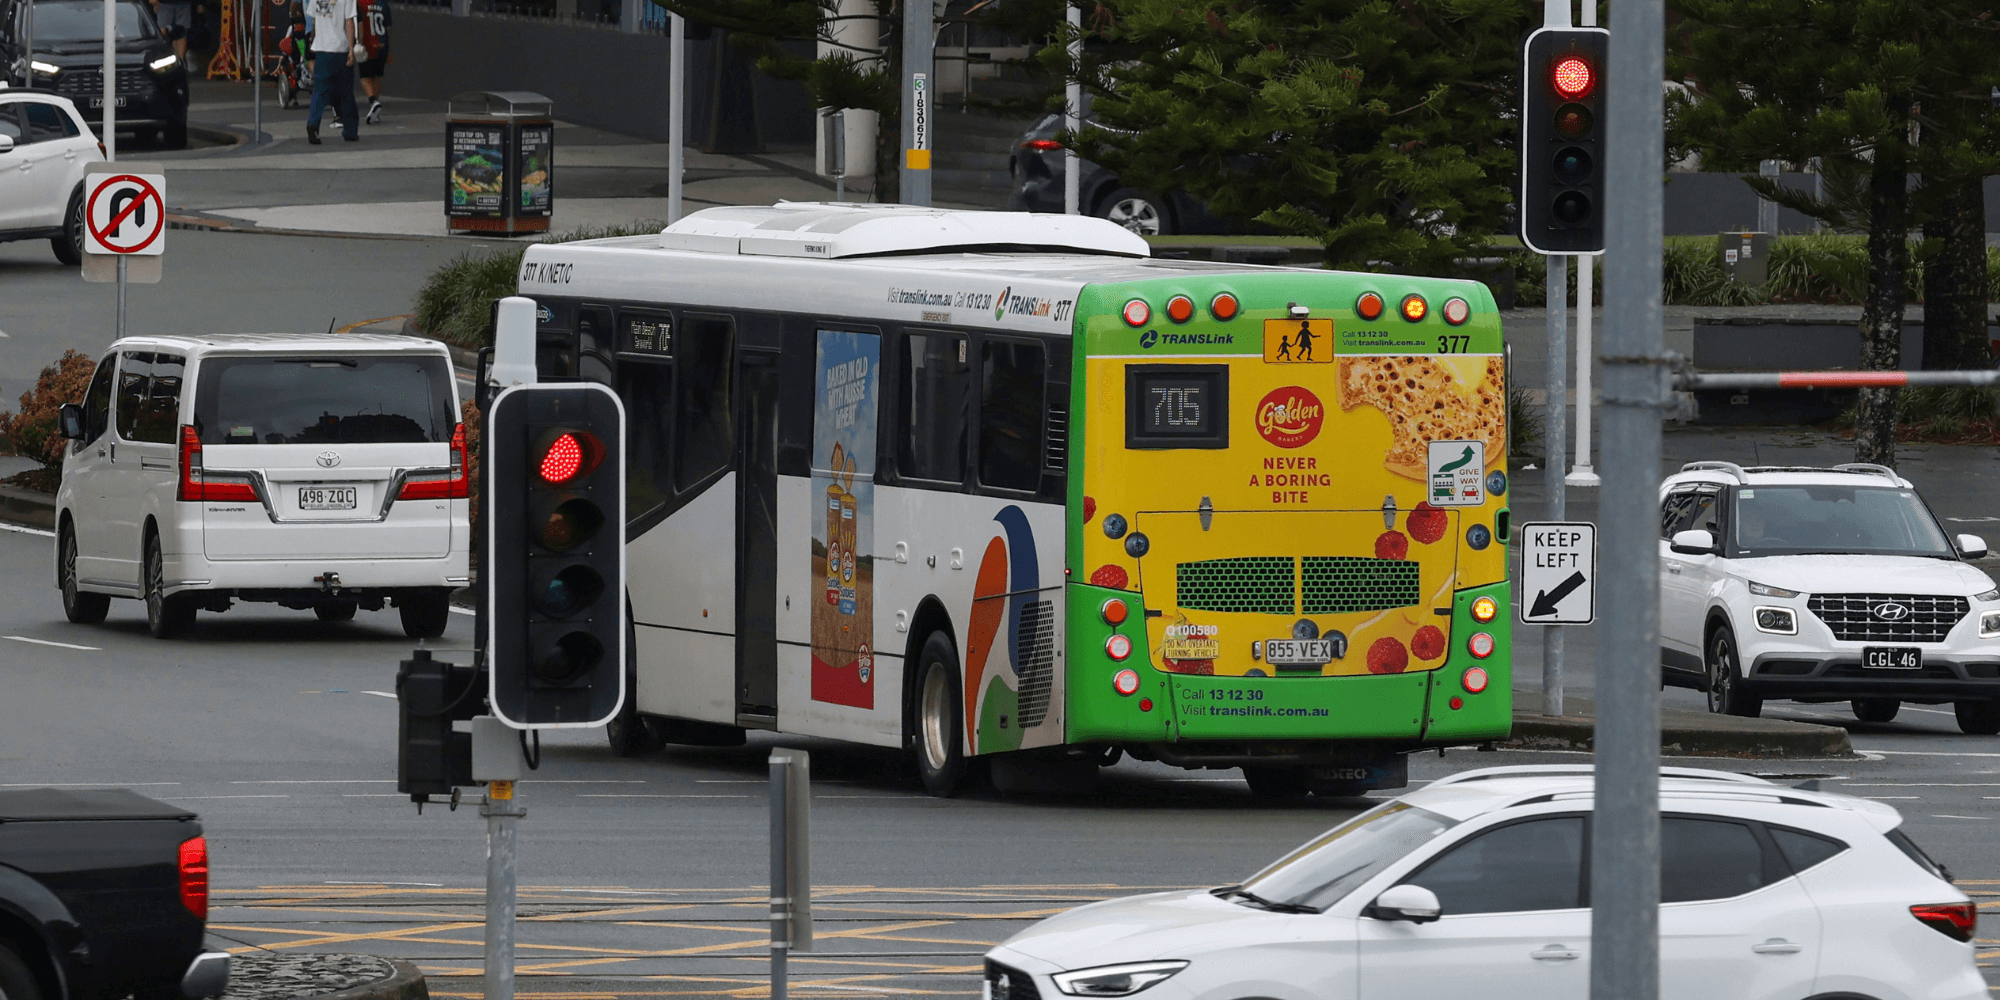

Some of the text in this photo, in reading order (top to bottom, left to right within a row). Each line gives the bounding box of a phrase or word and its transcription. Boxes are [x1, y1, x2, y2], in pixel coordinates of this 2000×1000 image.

[367, 12, 386, 36] 10
[523, 262, 538, 281] 377
[888, 287, 899, 303] Visit
[899, 288, 952, 306] translink.com.au
[954, 291, 967, 309] Call
[1008, 295, 1072, 322] TRANSLink 377
[1162, 333, 1234, 344] TRANSLink
[1342, 339, 1426, 347] Visit translink.com.au
[1437, 335, 1471, 354] 377
[1151, 387, 1200, 425] 705
[1259, 396, 1319, 435] Golden
[1263, 457, 1317, 470] NEVER
[1249, 474, 1331, 487] A BORING
[1272, 491, 1309, 504] BITE
[1535, 532, 1582, 547] KEEP
[1536, 553, 1579, 568] LEFT
[1166, 625, 1218, 636] Q100580
[1176, 639, 1187, 648] NOT
[1188, 640, 1216, 648] OVERTAKE
[1168, 649, 1217, 657] TURNING VEHICLE
[1182, 688, 1264, 700] Call 13 12 30
[1181, 704, 1329, 716] Visit translink.com.au
